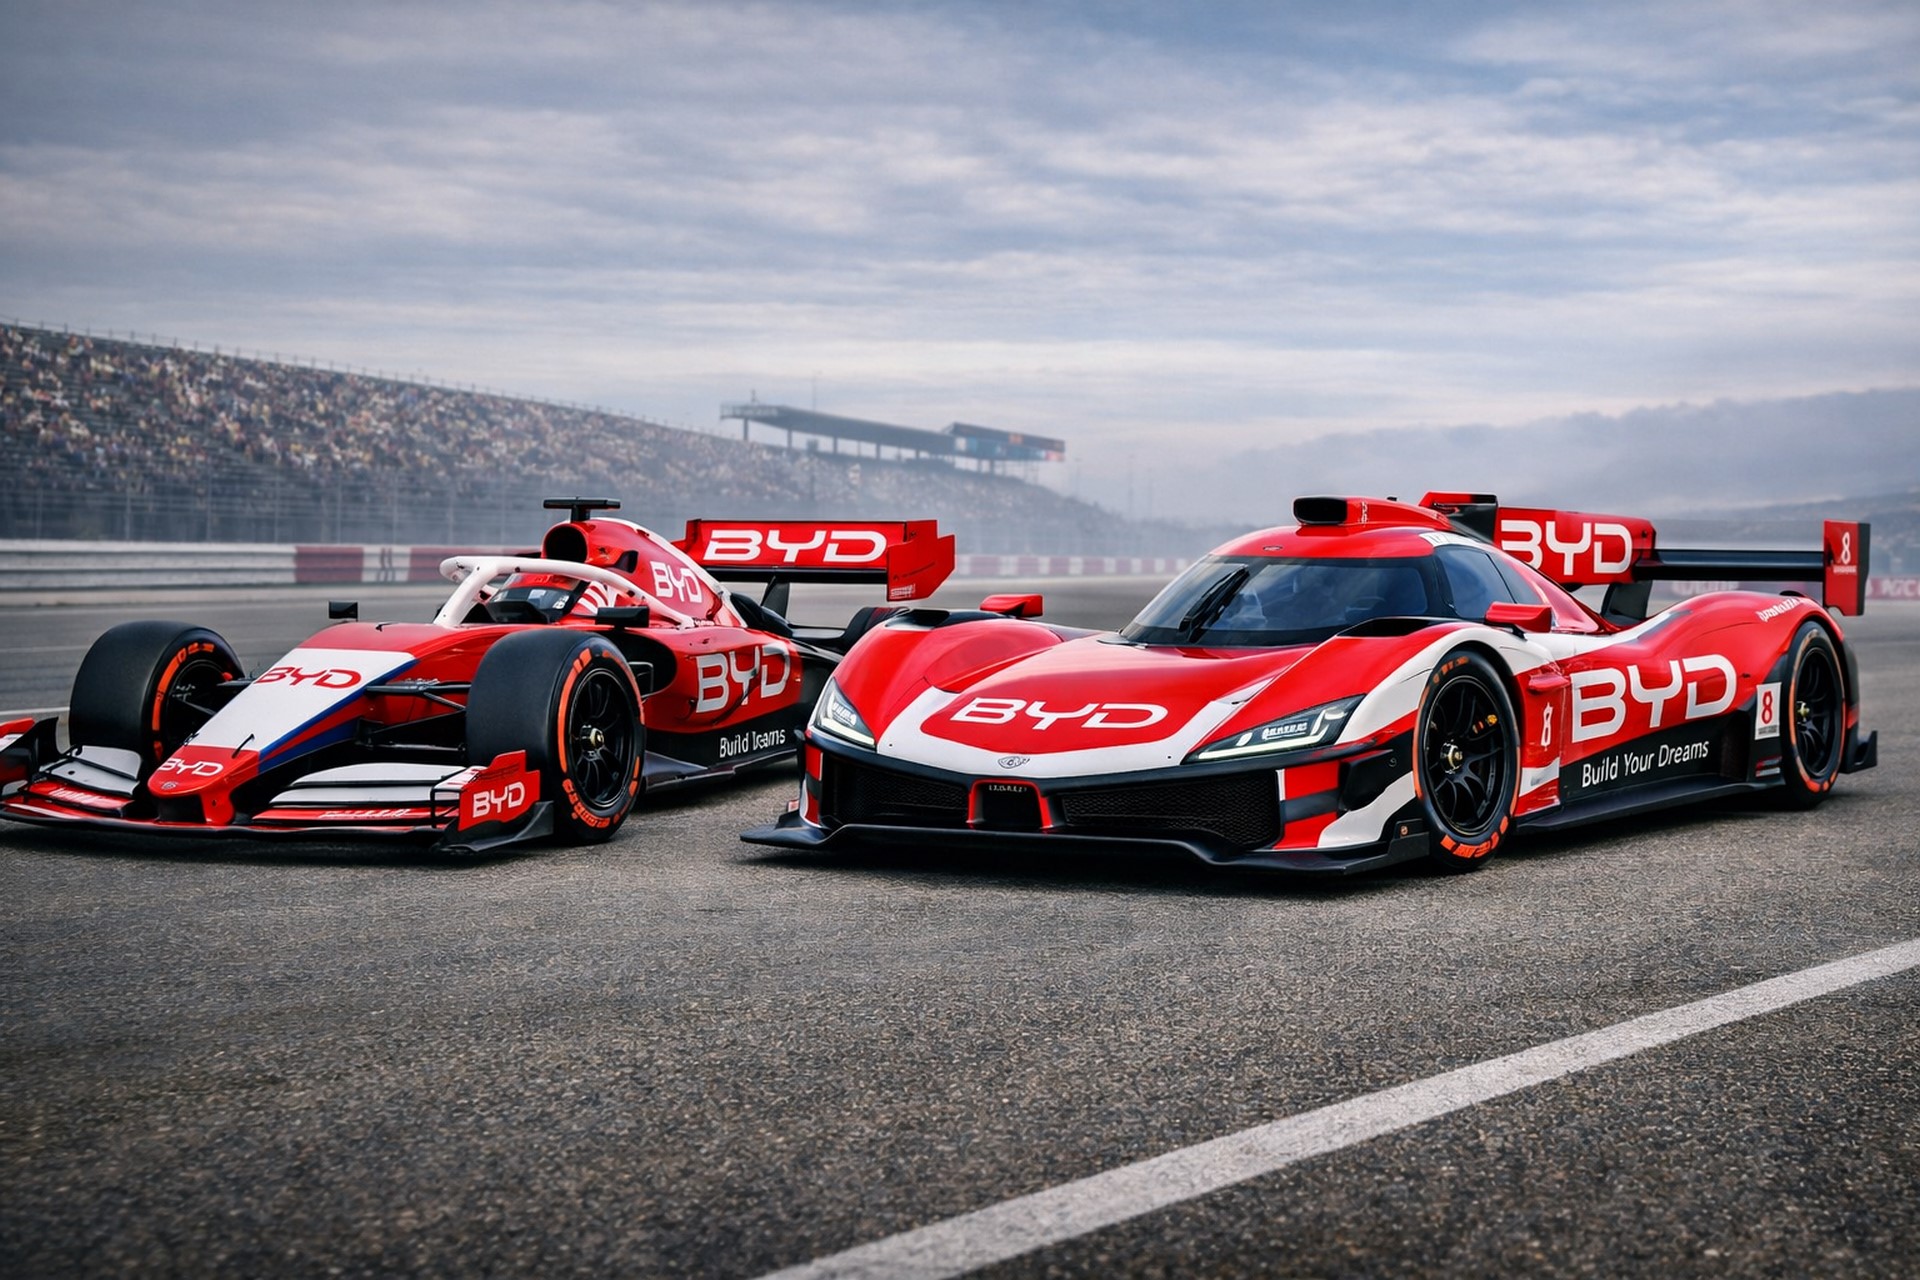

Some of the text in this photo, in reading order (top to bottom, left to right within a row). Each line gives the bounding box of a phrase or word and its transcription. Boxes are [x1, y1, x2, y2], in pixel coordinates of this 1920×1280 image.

[703, 529, 887, 562] BYD
[1500, 519, 1632, 574] BYD
[1841, 531, 1851, 565] 8
[651, 561, 703, 602] BYD
[254, 666, 361, 689] BYD
[696, 644, 791, 712] BYD
[950, 697, 1169, 731] BYD
[1571, 654, 1737, 743] BYD
[1761, 690, 1773, 725] 8
[158, 757, 224, 776] BYD
[1581, 740, 1710, 788] Build Your Dreams
[472, 781, 526, 818] BYD
